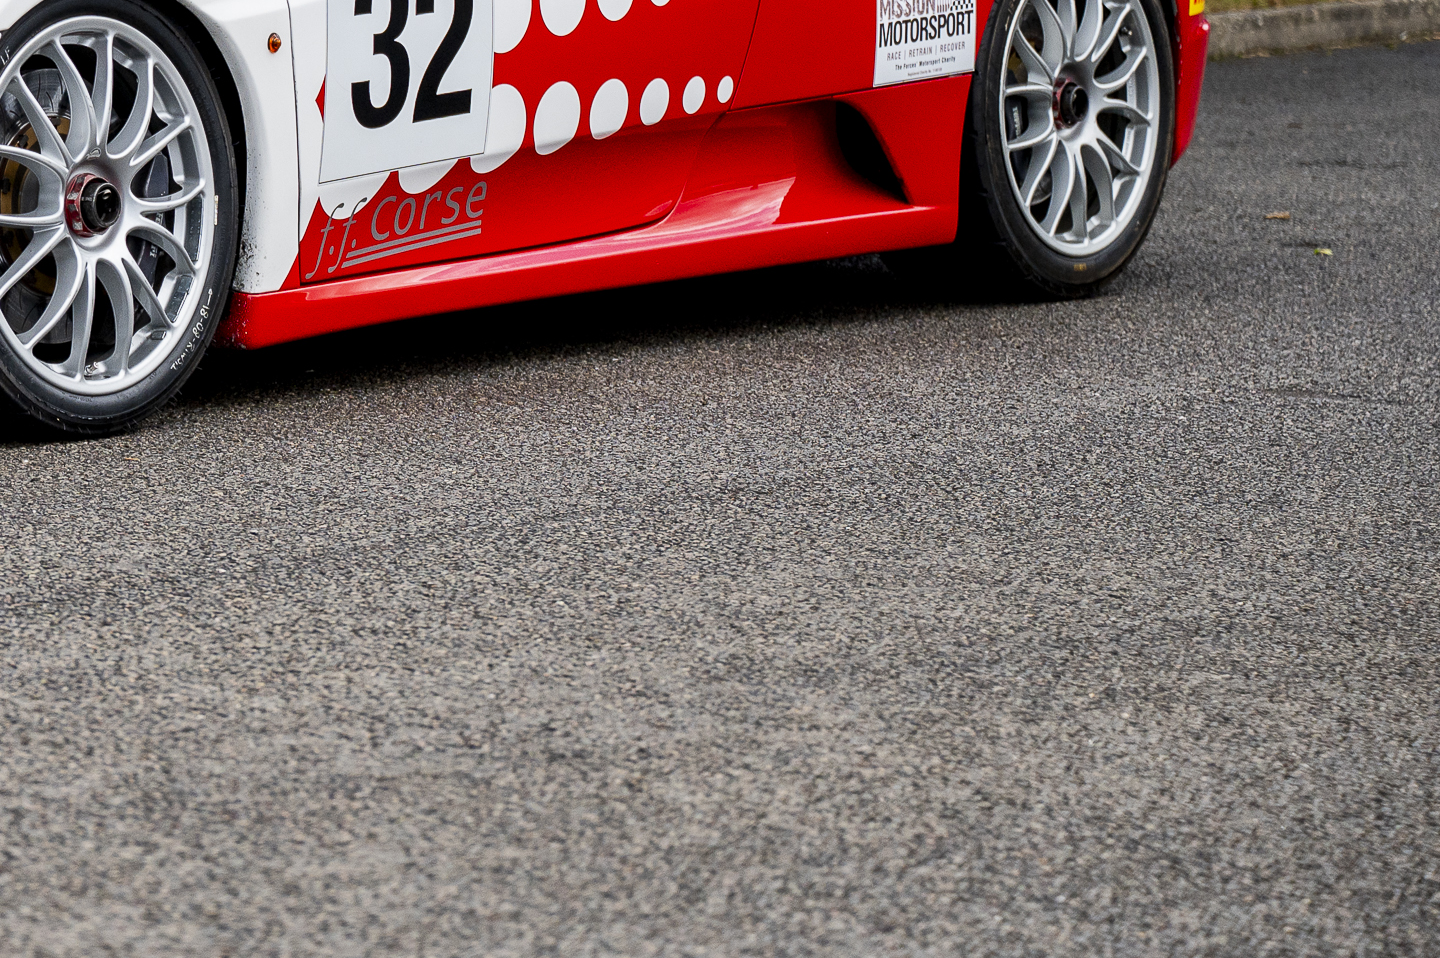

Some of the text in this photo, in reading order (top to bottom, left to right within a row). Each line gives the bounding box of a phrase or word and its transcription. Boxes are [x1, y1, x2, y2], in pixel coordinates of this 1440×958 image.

[878, 9, 974, 48] MOTORSPORT
[886, 41, 966, 62] RACE RETRAIN RECOVER
